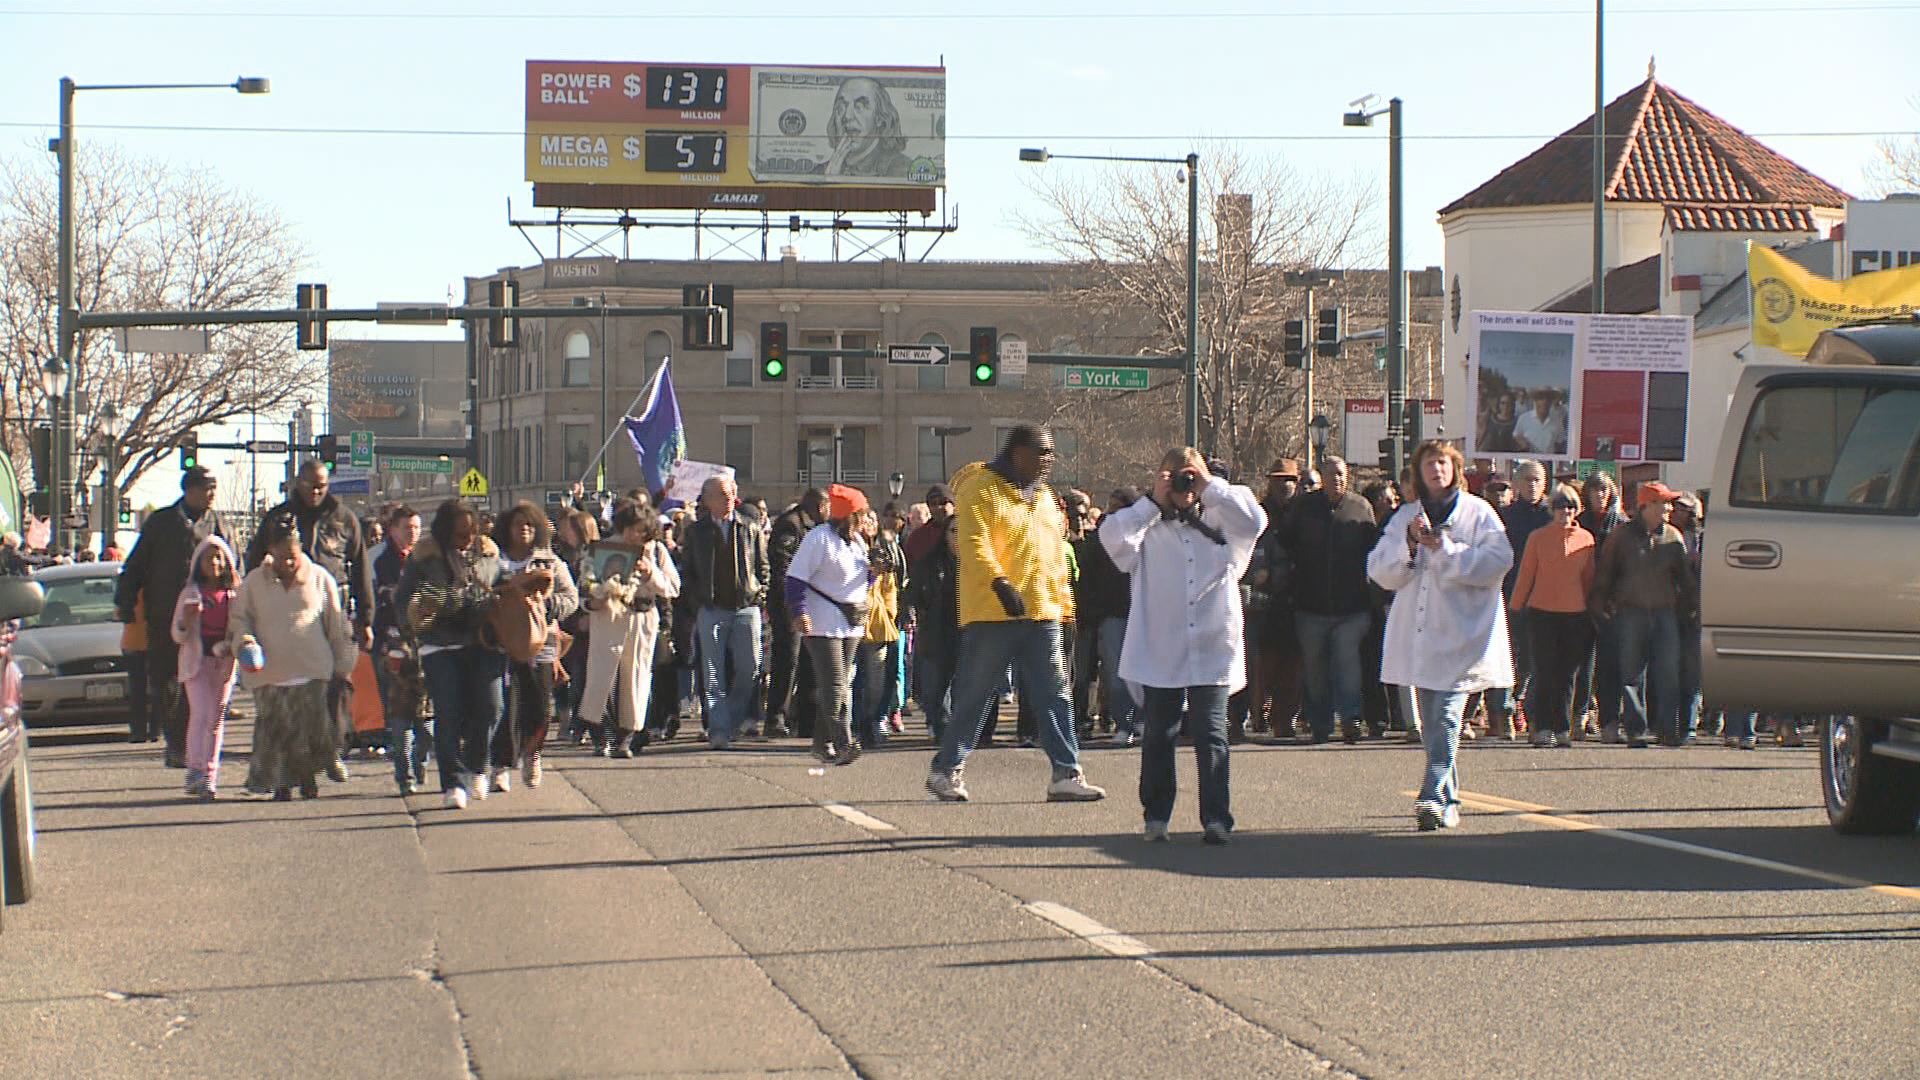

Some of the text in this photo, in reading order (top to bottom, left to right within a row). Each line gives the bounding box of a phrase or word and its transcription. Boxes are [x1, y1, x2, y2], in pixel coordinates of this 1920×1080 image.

[541, 73, 611, 89] POWER
[623, 72, 724, 104] $ 131
[541, 89, 590, 104] BALL
[681, 111, 721, 120] MILLION
[541, 136, 608, 154] MEGA
[623, 136, 723, 168] $ 51
[541, 155, 609, 168] MILLIONS
[680, 173, 721, 182] MILLION
[908, 172, 938, 181] LOTTERY
[713, 193, 759, 203] LAMAR
[553, 264, 599, 277] AUSTIN
[1800, 299, 1847, 312] NAACP
[1850, 304, 1897, 313] Denver
[1480, 315, 1493, 324] The
[1495, 315, 1514, 324] truth
[1516, 316, 1529, 325] will
[1531, 317, 1544, 325] set
[1545, 317, 1557, 325] US
[914, 351, 931, 359] WAY
[1085, 371, 1120, 385] York
[384, 388, 417, 397] SHOUT
[1352, 403, 1380, 412] Drive
[355, 447, 369, 455] 70
[391, 457, 438, 472] Josephine
